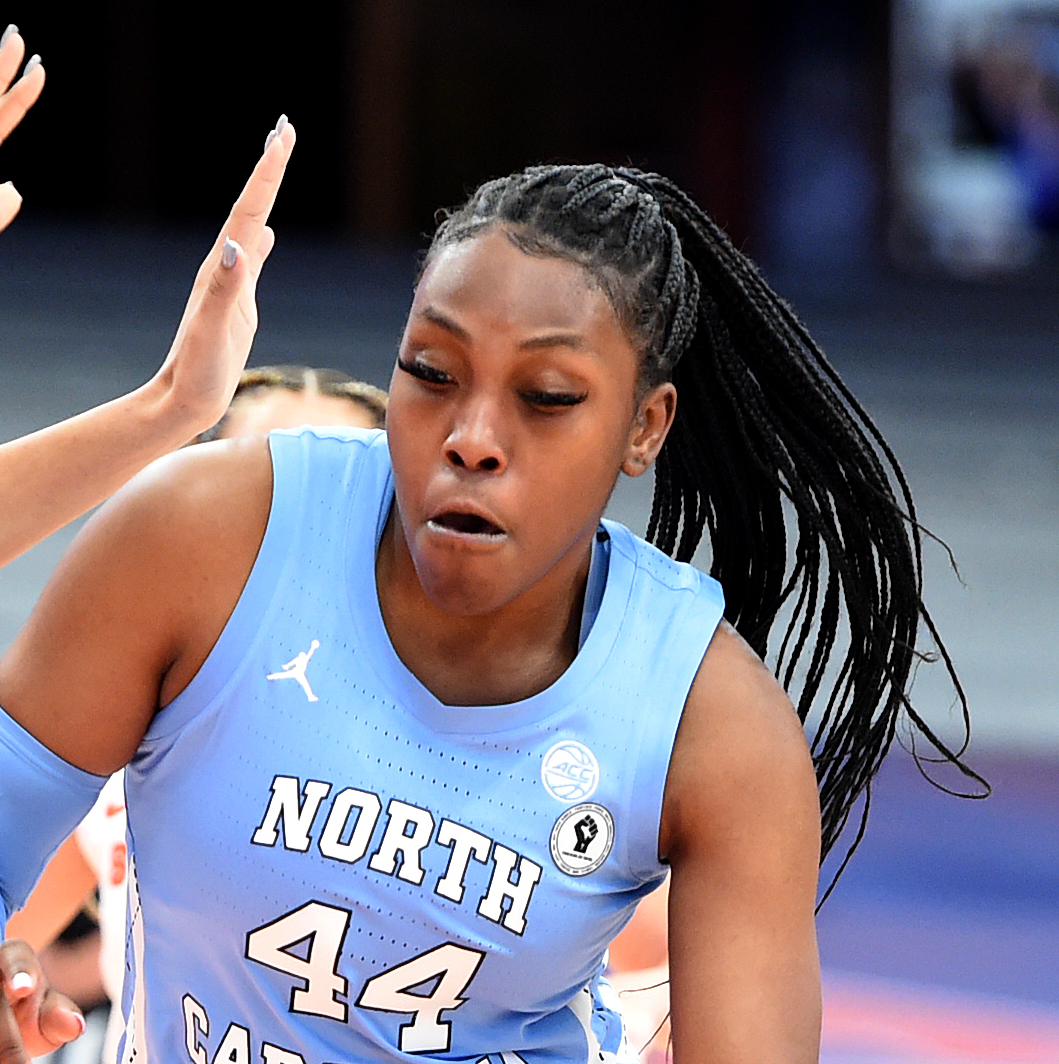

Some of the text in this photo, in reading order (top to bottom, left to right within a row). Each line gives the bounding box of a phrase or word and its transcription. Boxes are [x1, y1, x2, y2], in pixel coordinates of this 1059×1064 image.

[552, 762, 592, 781] ACC
[251, 775, 542, 936] NORTH
[245, 901, 487, 1054] 44
